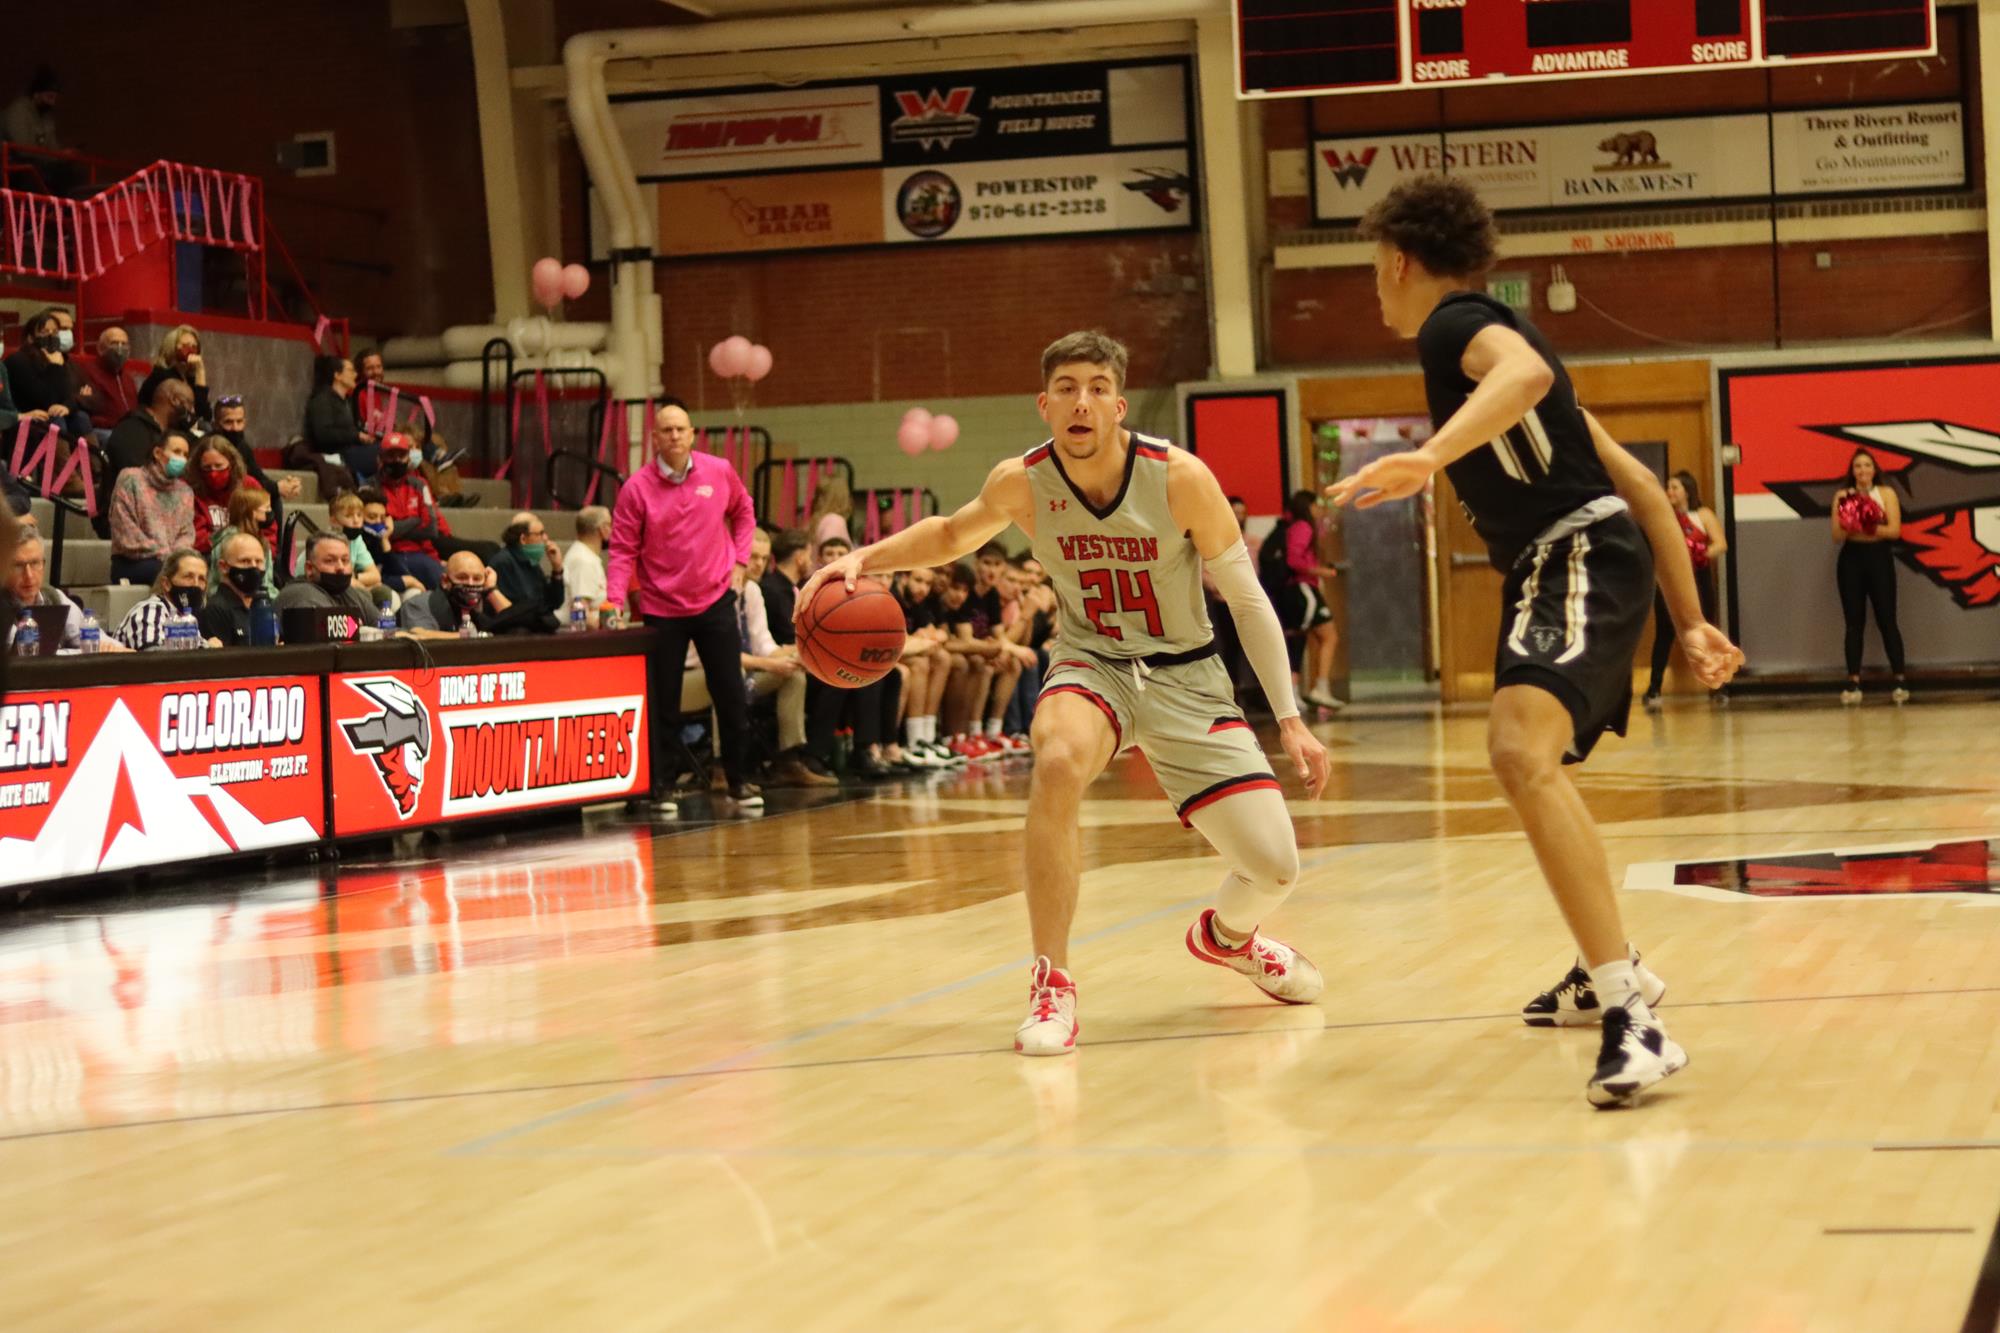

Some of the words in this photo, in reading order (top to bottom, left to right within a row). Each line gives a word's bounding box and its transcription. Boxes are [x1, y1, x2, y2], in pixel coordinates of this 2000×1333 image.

[1531, 49, 1630, 73] ADVANTAGE
[1691, 41, 1748, 63] SCORE
[1414, 59, 1470, 81] SCORE
[988, 89, 1103, 110] MOUNTAINEER
[997, 117, 1042, 134] FIELD
[1045, 114, 1096, 131] HOUSE
[1805, 115, 1849, 131] Three
[1854, 112, 1903, 129] Rivers
[1907, 109, 1958, 126] Resort
[1833, 135, 1848, 149] &
[1853, 131, 1929, 147] Outfitting
[1390, 139, 1538, 171] WESTERN
[1815, 156, 1837, 170] Go
[976, 175, 1098, 197] POWERSTOP
[1562, 176, 1619, 195] BANK
[1640, 171, 1698, 190] WEST
[1571, 235, 1593, 252] NO
[1604, 231, 1675, 250] SMOKING
[1057, 534, 1159, 563] WESTERN
[1078, 568, 1164, 641] 24
[327, 614, 348, 639] POSS
[440, 674, 478, 706] HOME
[480, 673, 498, 703] OF
[499, 671, 526, 701] THE
[159, 685, 305, 755] COLORADO
[449, 708, 637, 801] MOUNTAINEERS
[210, 760, 264, 785] ELEVATION
[24, 781, 50, 805] GYM
